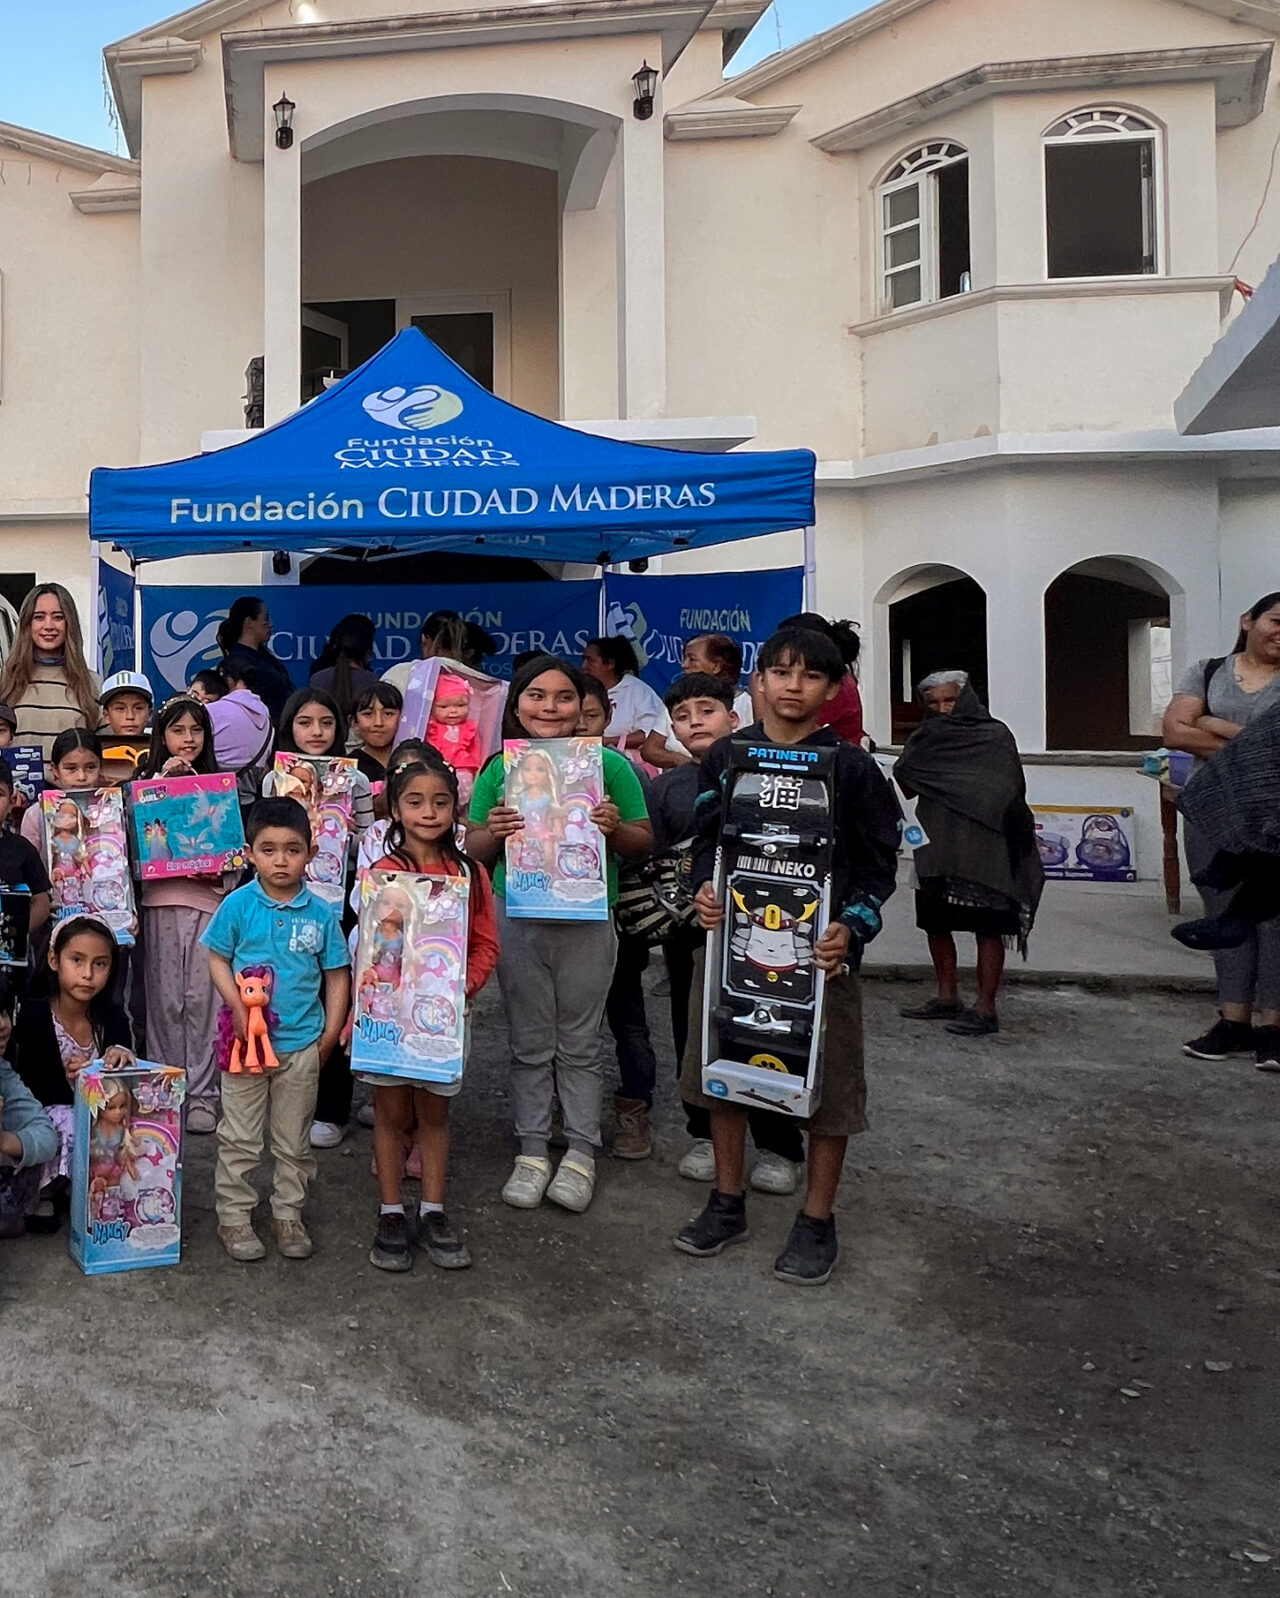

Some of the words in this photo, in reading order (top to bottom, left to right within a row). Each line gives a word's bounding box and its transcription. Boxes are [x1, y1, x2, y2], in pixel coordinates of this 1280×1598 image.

[347, 435, 493, 448] Fundación
[334, 447, 513, 462] CIUDAD
[170, 492, 364, 525] Fundación
[378, 487, 539, 518] CIUDAD
[548, 482, 716, 513] MADERAS
[679, 604, 751, 632] FUNDACIÓN
[490, 630, 589, 656] DERAS
[748, 747, 818, 763] PATINETA
[512, 869, 551, 893] NANCY
[773, 859, 816, 878] NEKO
[360, 1014, 402, 1046] NANCY
[92, 1219, 129, 1245] NANCY
